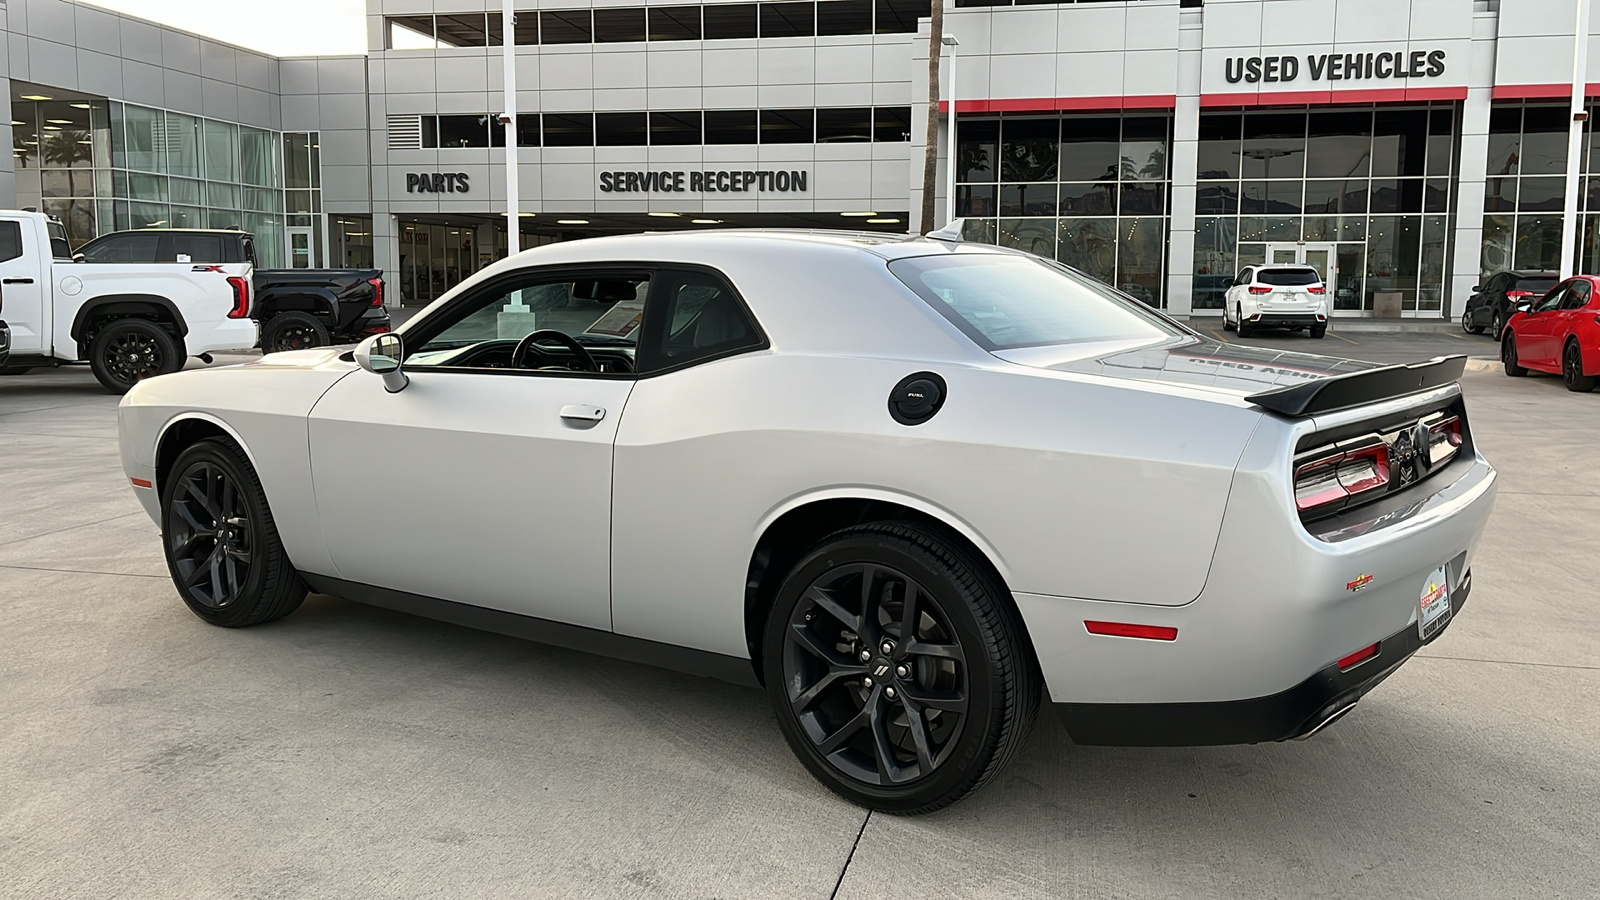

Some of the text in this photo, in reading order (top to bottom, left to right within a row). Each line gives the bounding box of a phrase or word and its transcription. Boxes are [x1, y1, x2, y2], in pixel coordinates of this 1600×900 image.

[1225, 50, 1446, 84] USED VEHICLES
[406, 172, 469, 193] PARTS
[599, 171, 808, 193] SERVICE RECEPTION
